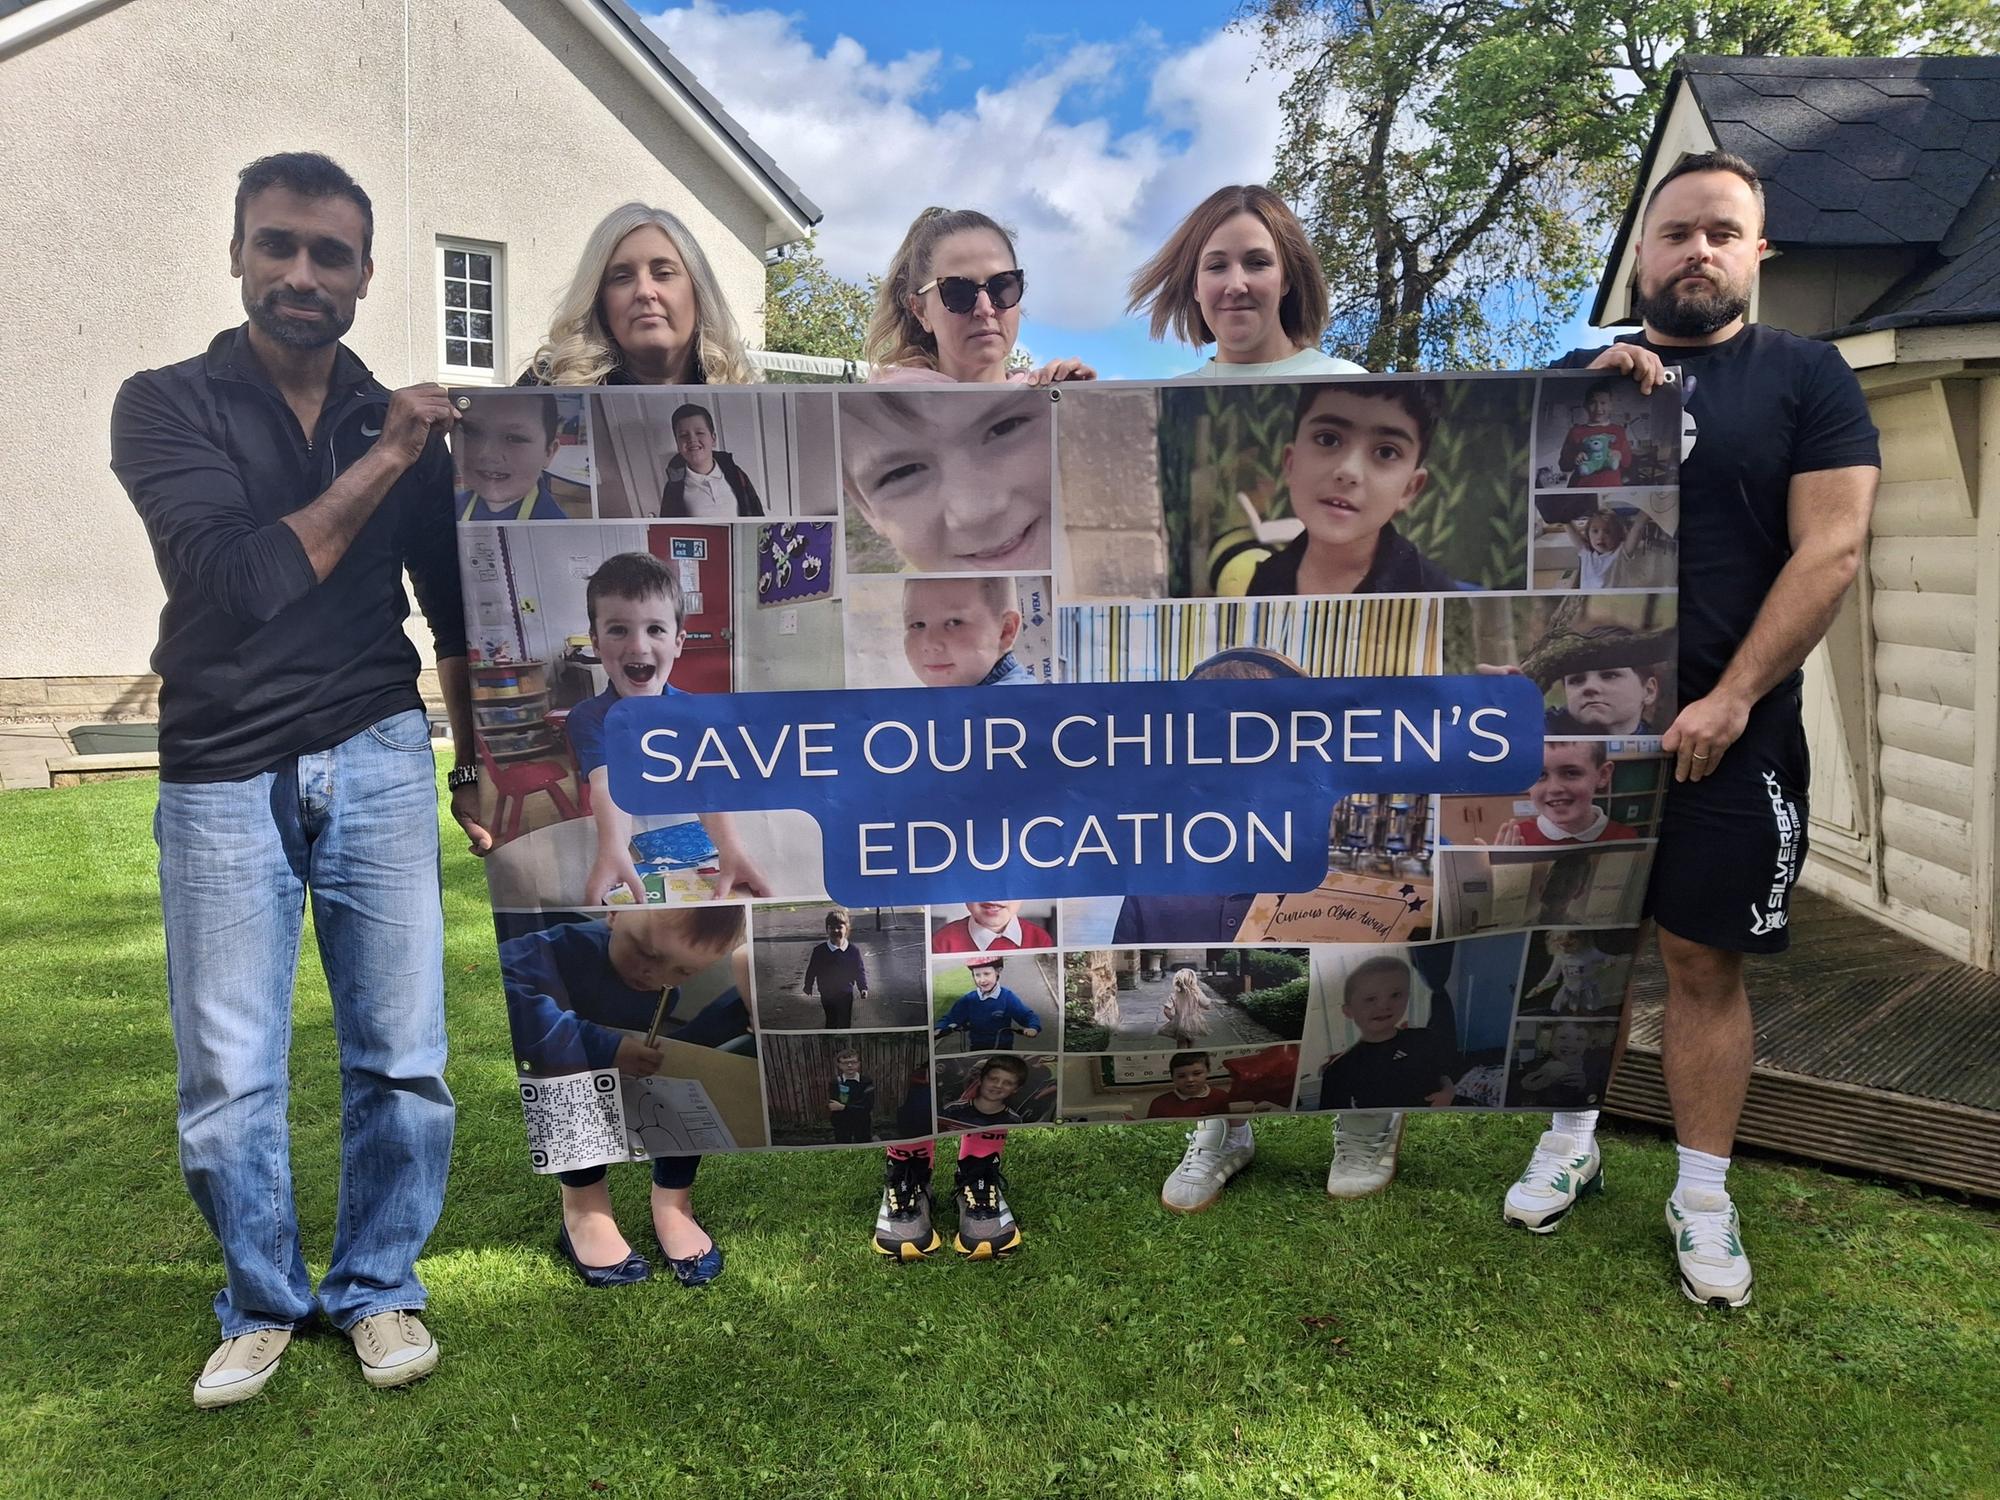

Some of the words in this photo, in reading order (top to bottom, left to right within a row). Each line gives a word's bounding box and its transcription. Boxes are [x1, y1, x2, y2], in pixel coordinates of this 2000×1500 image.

[1031, 591, 1041, 613] VEKA
[1042, 657, 1052, 679] VEKA
[640, 723, 839, 783] SAVE
[863, 718, 1027, 774] OUR
[1051, 705, 1511, 768] CHILDREN'S
[1786, 801, 1801, 829] STRONG
[859, 811, 1292, 876] EDUCATION
[1762, 770, 1793, 908] SILVERBACK
[1793, 828, 1801, 844] THE
[1790, 844, 1800, 862] WITH
[1788, 861, 1797, 883] WALK
[1275, 908, 1323, 925] Curious
[1327, 904, 1358, 921] Clyde
[1358, 911, 1392, 936] Award
